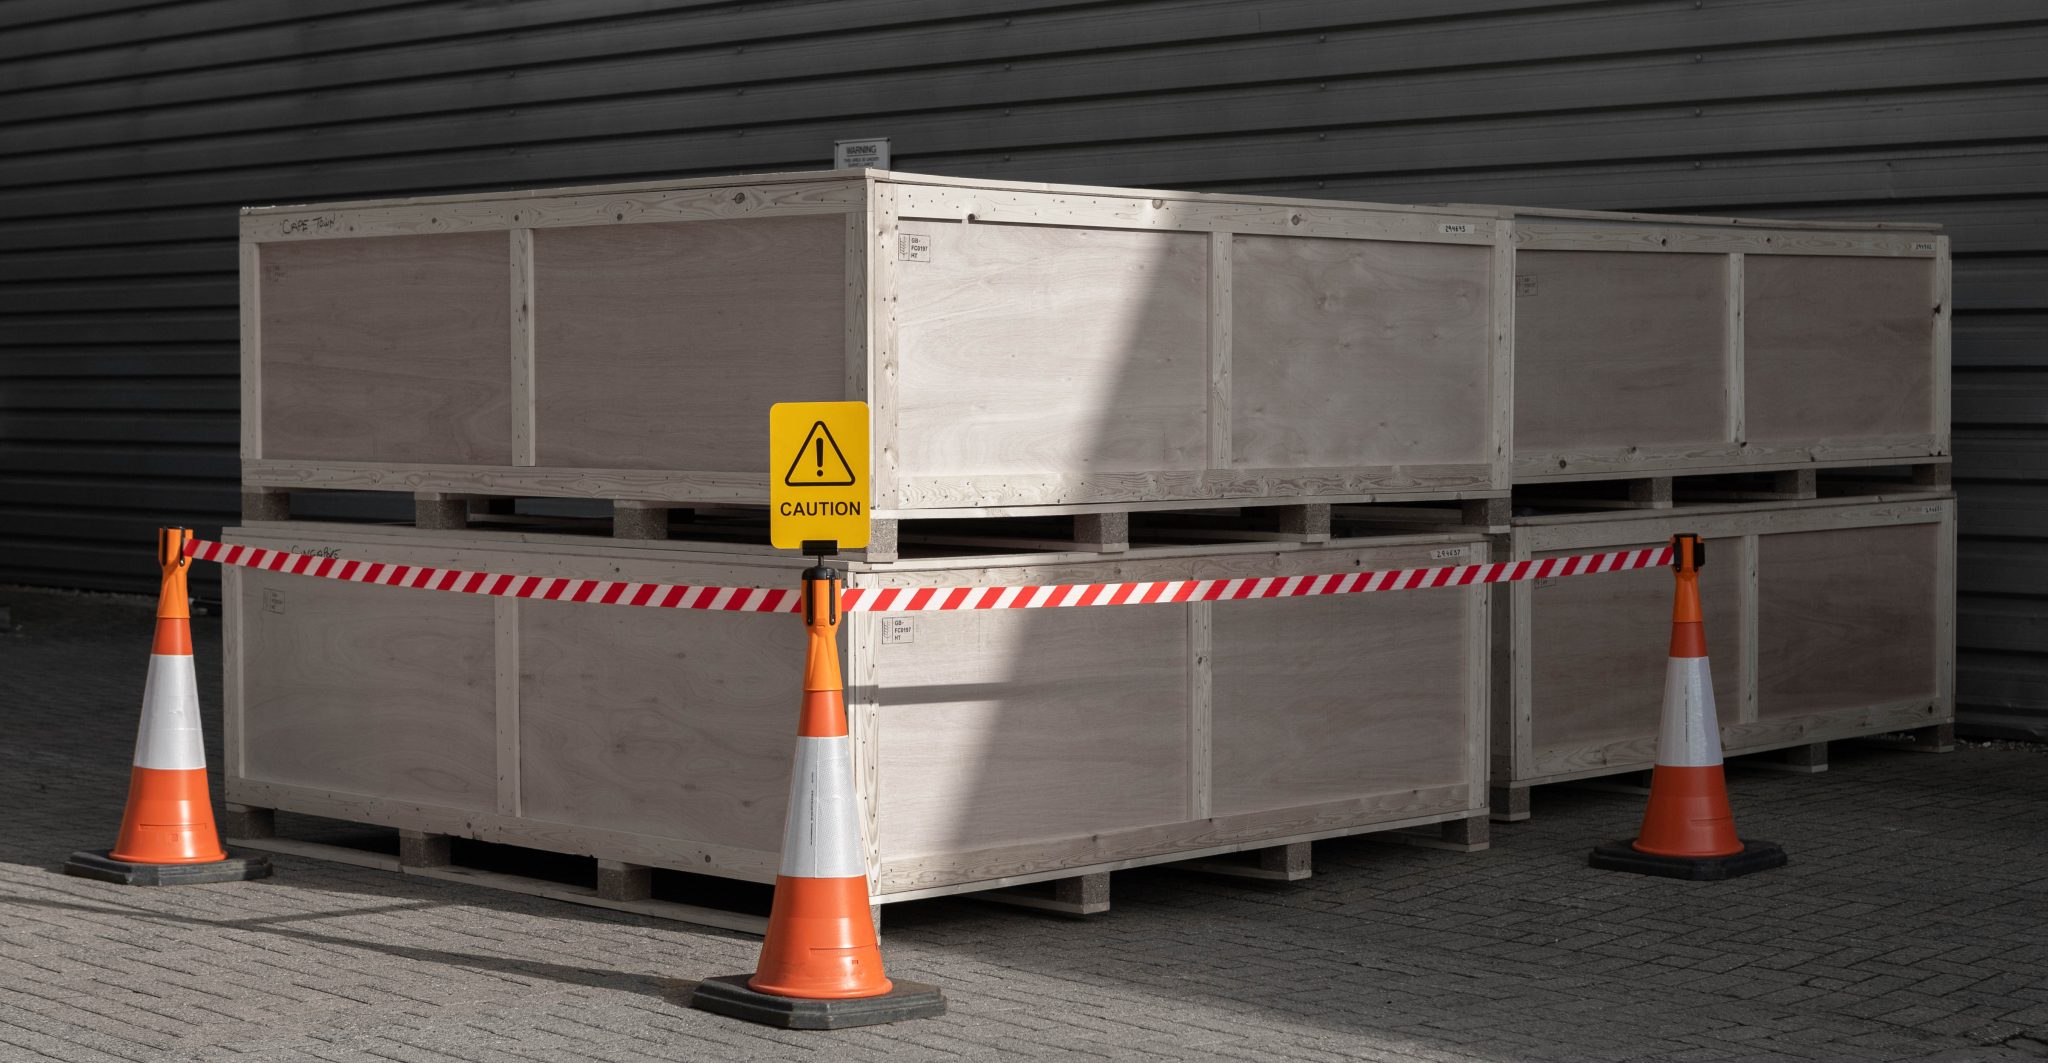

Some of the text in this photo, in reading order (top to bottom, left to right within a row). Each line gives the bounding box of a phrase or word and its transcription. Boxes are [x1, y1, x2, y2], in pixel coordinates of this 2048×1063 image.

[846, 145, 877, 155] WARNING
[283, 219, 309, 234] CAPE
[780, 502, 861, 516] CAUTION
